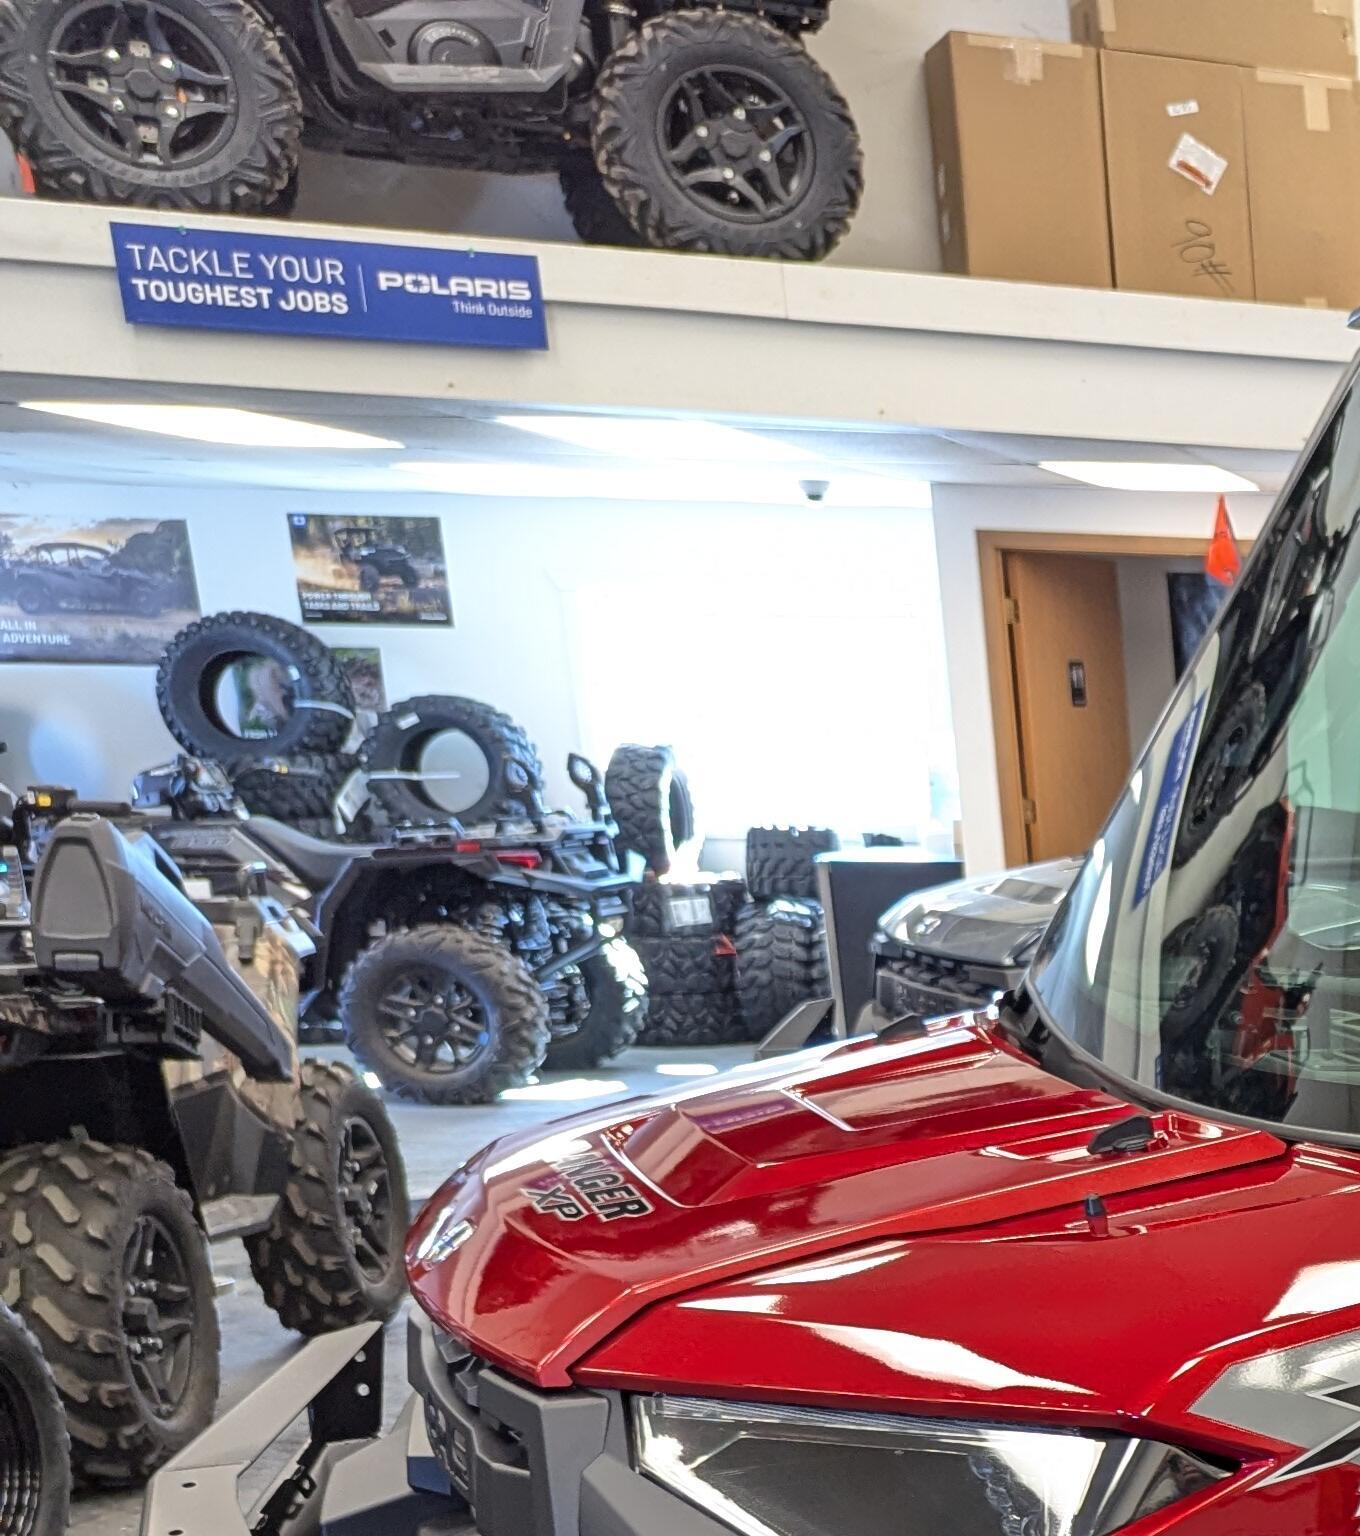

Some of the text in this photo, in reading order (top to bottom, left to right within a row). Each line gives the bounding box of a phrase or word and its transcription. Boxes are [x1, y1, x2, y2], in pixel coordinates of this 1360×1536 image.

[126, 244, 346, 286] TACKLE YOUR
[132, 279, 349, 316] TOUGHEST JOBS
[378, 271, 532, 300] POLARIS
[452, 299, 533, 319] Think Outside
[3, 632, 71, 646] ADVENTURE
[521, 1183, 590, 1222] XP
[551, 1148, 656, 1223] ANGER
